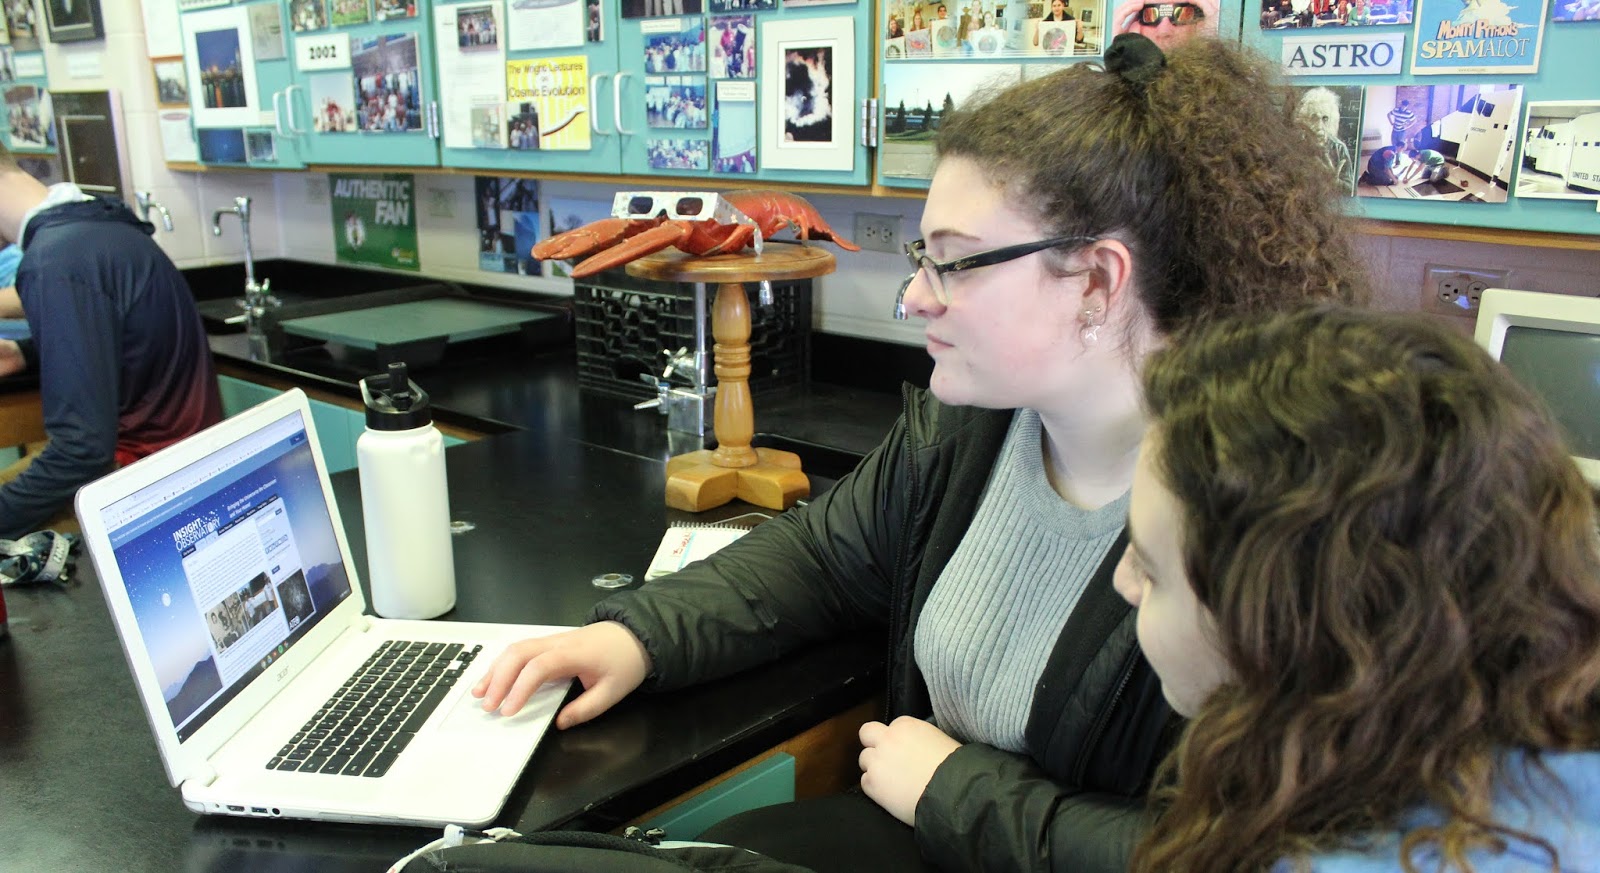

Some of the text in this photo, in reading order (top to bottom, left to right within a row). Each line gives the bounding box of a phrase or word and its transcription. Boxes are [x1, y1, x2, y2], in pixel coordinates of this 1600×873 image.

[309, 45, 336, 60] 2002
[1288, 42, 1394, 68] ASTRO
[1421, 38, 1530, 59] SPAMALOT
[508, 62, 583, 75] The Wright Lectures
[509, 86, 585, 98] Cosmic Evolution
[1572, 171, 1589, 181] UNITED
[334, 178, 410, 200] AUTHENTIC
[374, 200, 410, 226] FAN
[172, 517, 202, 542] INSIGHT
[175, 516, 221, 552] OBSERVATORY
[276, 665, 289, 682] acer
